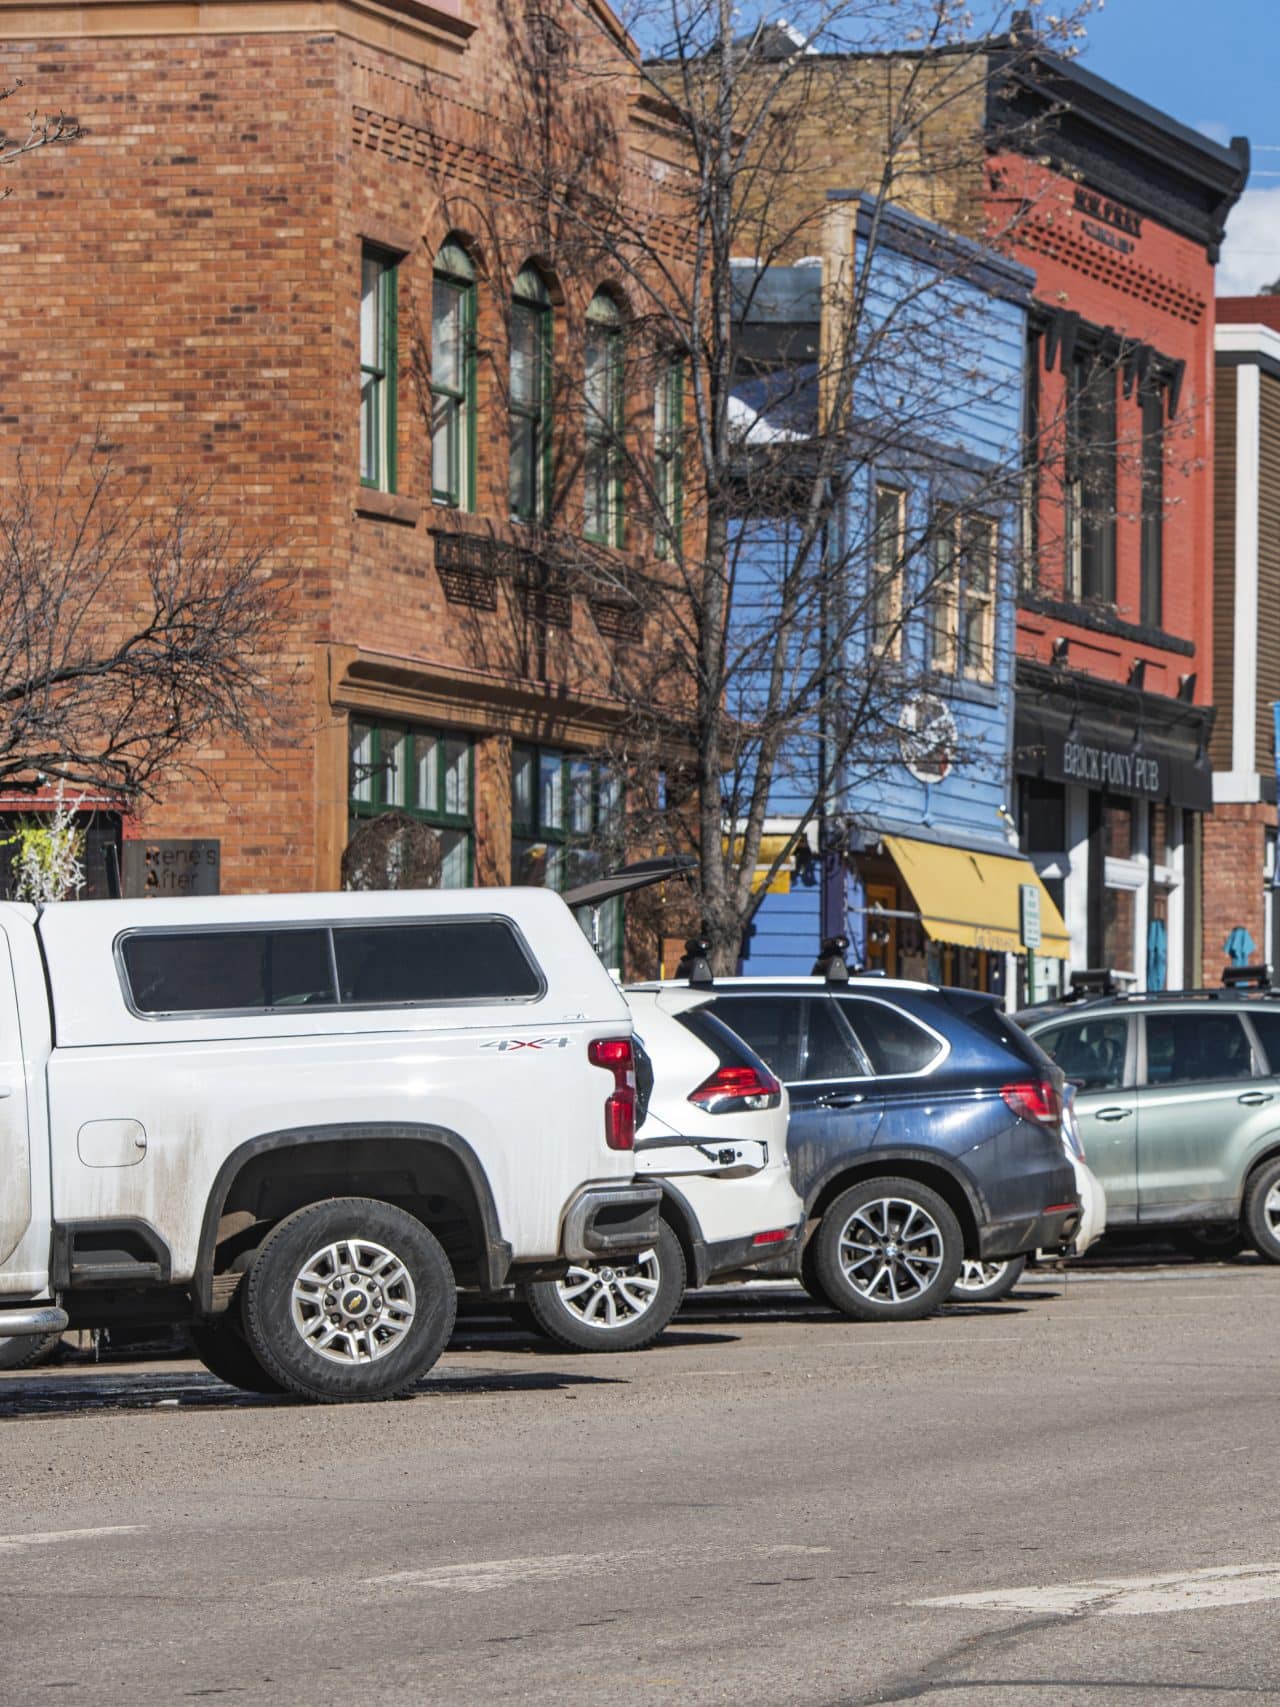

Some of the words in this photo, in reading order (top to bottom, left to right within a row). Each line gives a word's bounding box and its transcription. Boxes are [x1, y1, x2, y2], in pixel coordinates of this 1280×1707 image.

[1064, 741, 1100, 779] BRICK
[1135, 757, 1160, 791] PUB
[145, 846, 217, 866] Rene's
[143, 869, 199, 890] After
